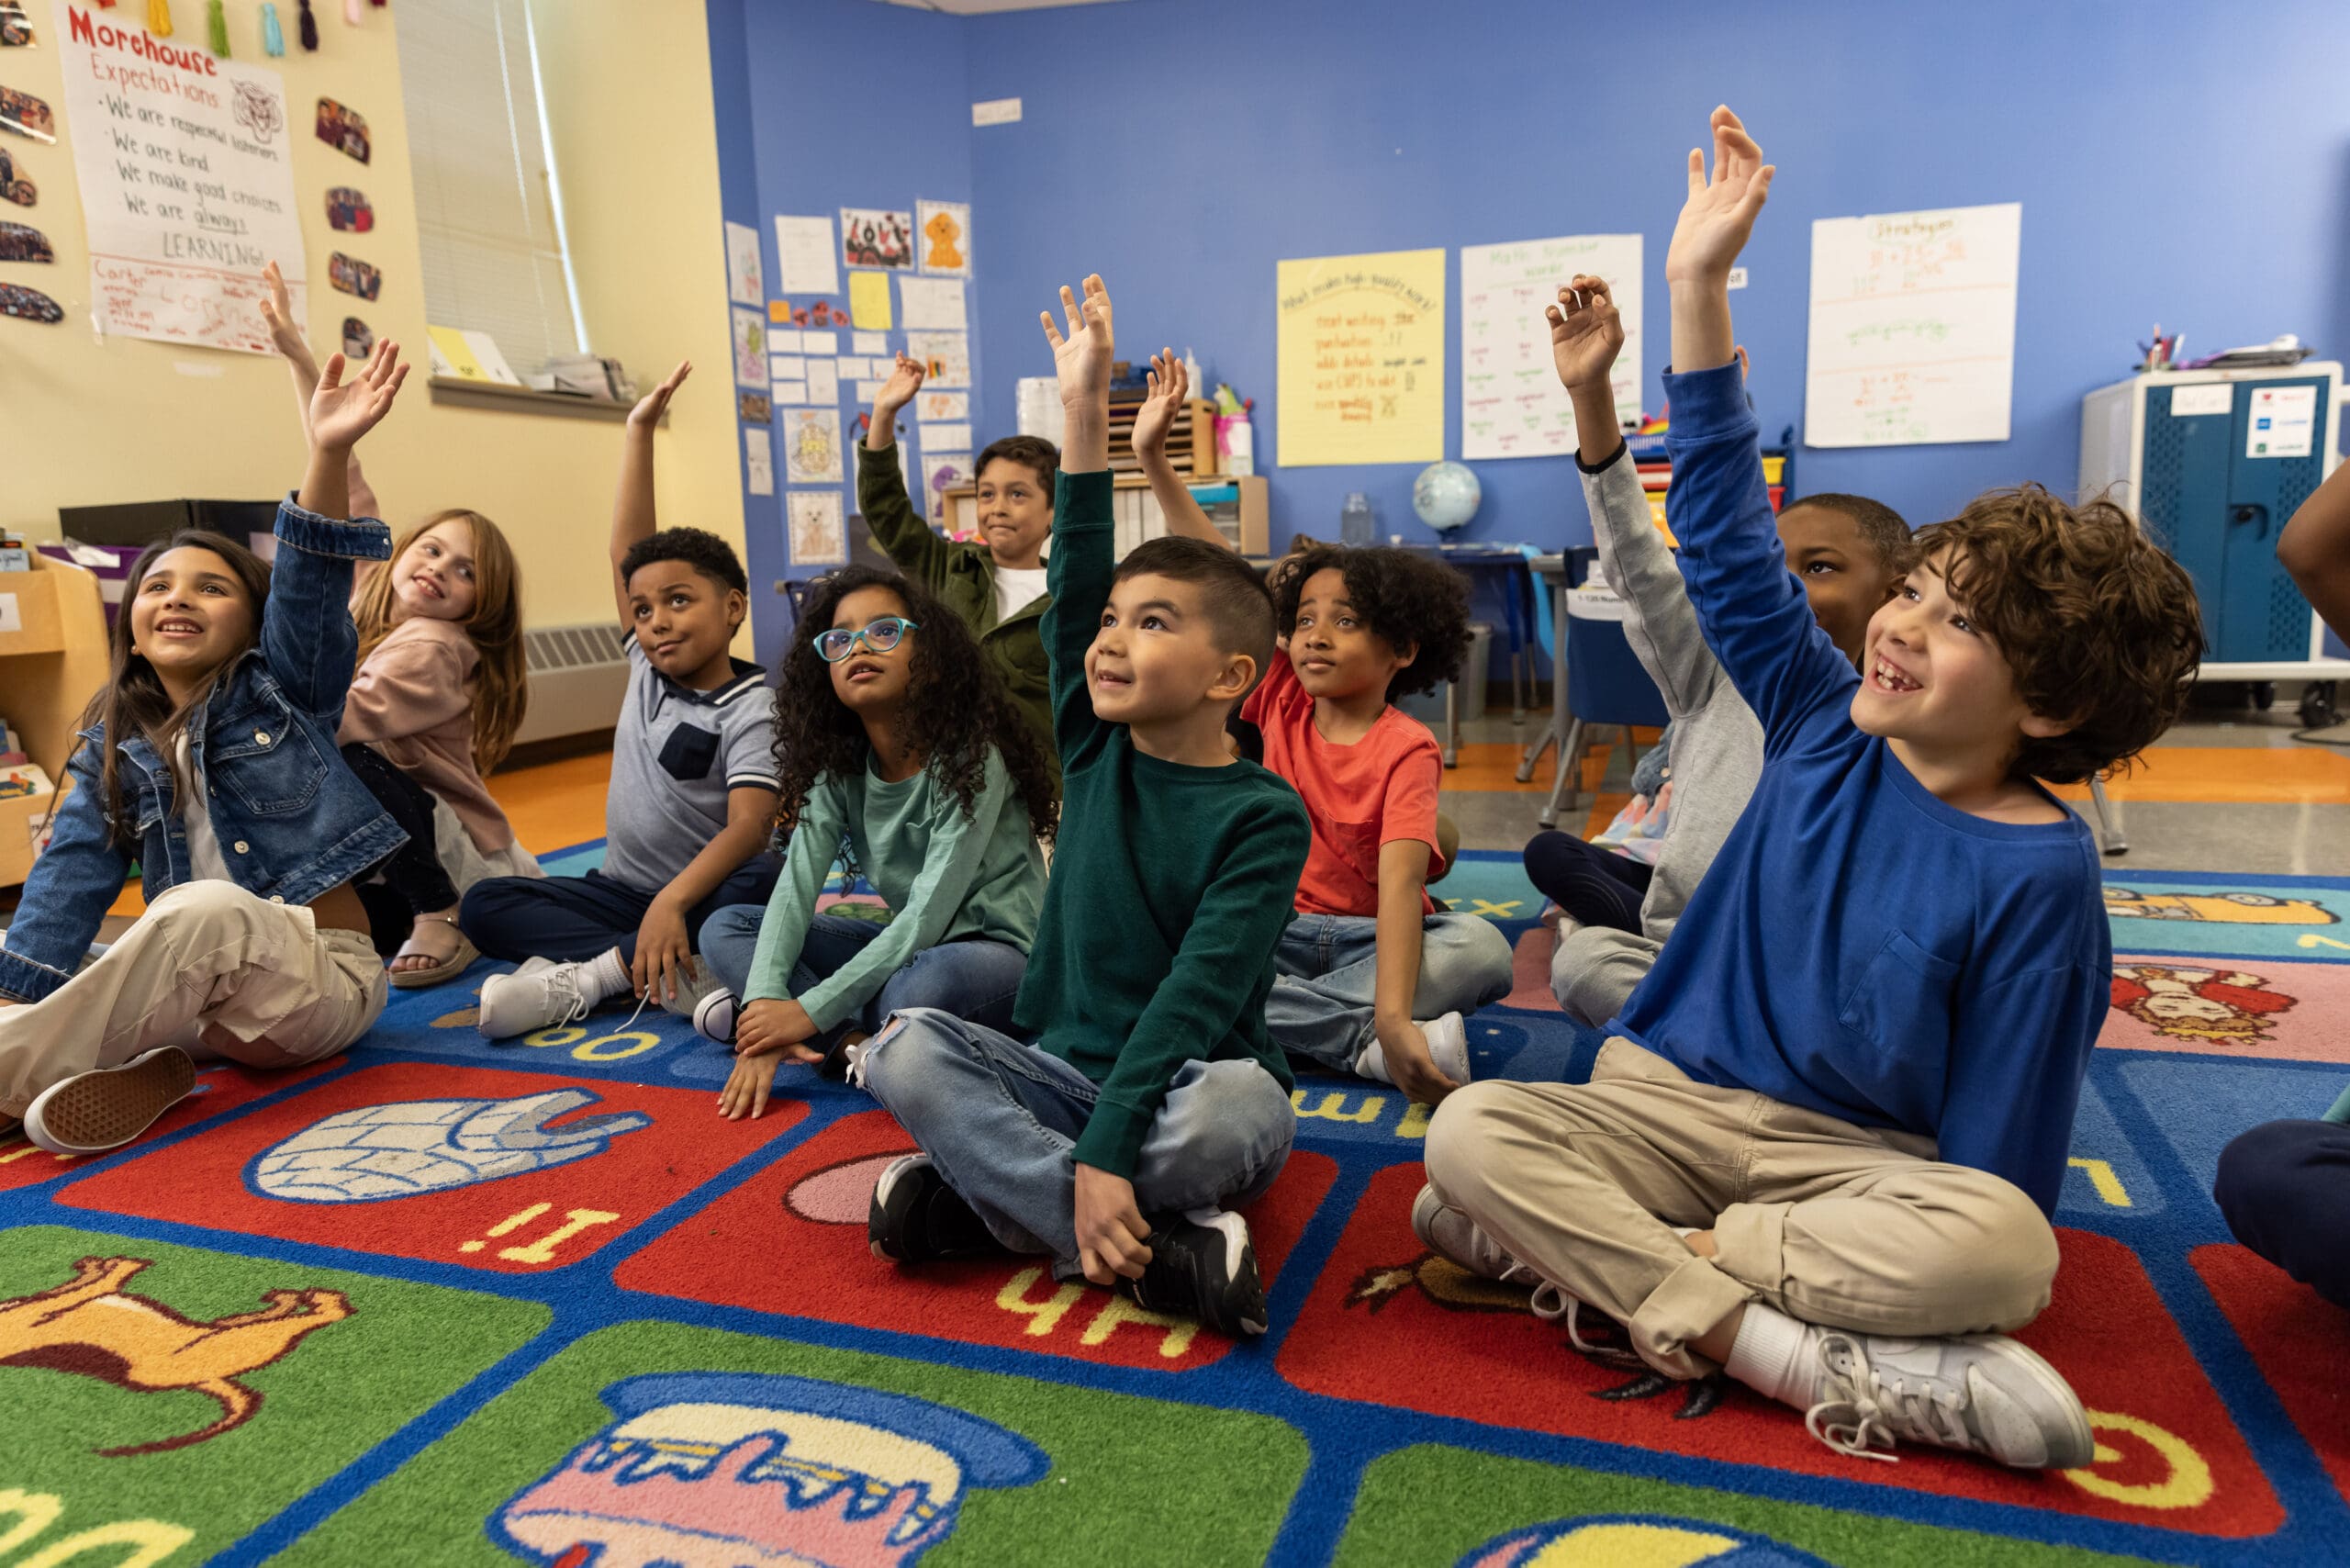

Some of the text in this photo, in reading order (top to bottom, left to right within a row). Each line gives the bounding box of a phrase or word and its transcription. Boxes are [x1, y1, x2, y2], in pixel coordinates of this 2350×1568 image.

[68, 5, 218, 76] Morehouse
[90, 52, 220, 108] Expectations
[106, 94, 132, 119] We
[139, 106, 164, 126] are
[171, 116, 227, 145] respectful
[112, 128, 210, 172] We are kind
[116, 159, 283, 214] We make good choices
[124, 192, 247, 235] We are always
